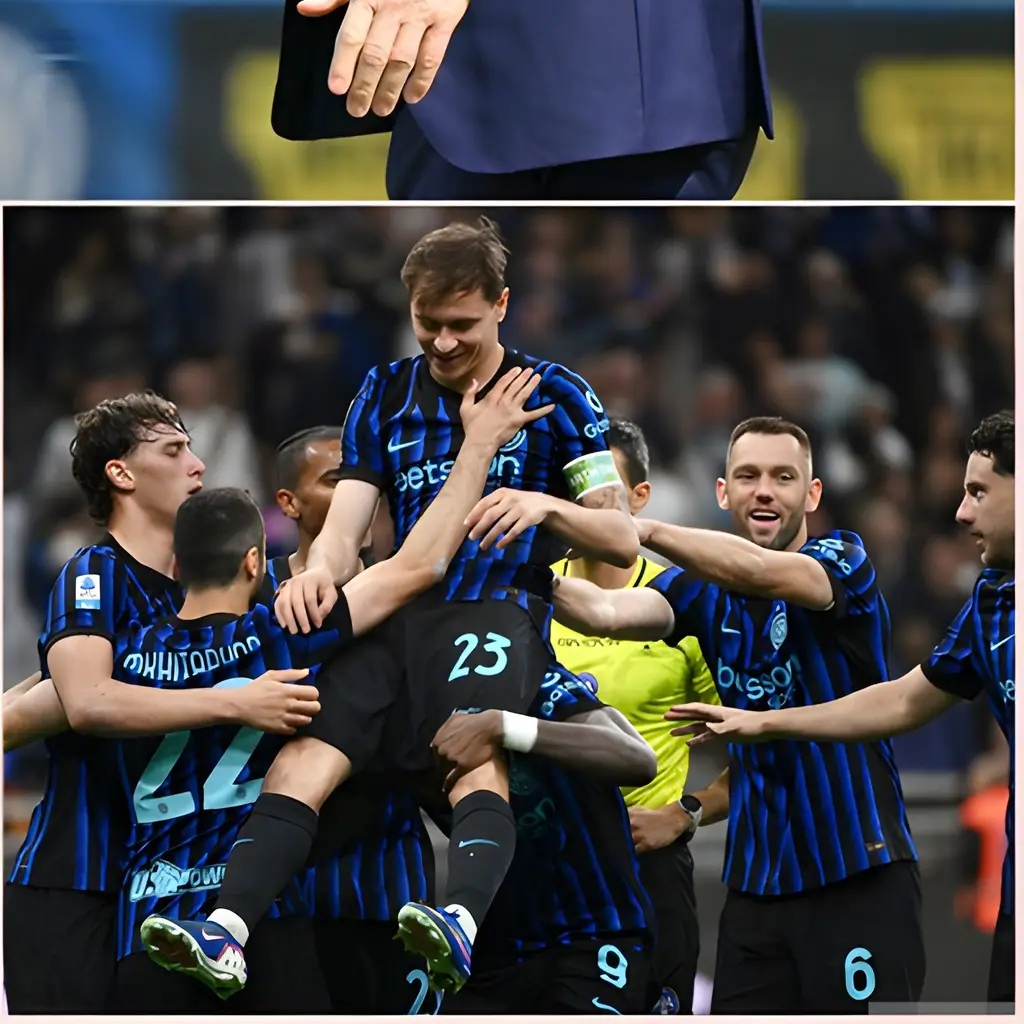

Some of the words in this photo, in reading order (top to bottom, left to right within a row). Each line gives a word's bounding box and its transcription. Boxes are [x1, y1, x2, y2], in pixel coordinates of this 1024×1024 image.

[448, 631, 512, 683] 23
[596, 944, 628, 989] 9
[843, 947, 876, 1001] 6
